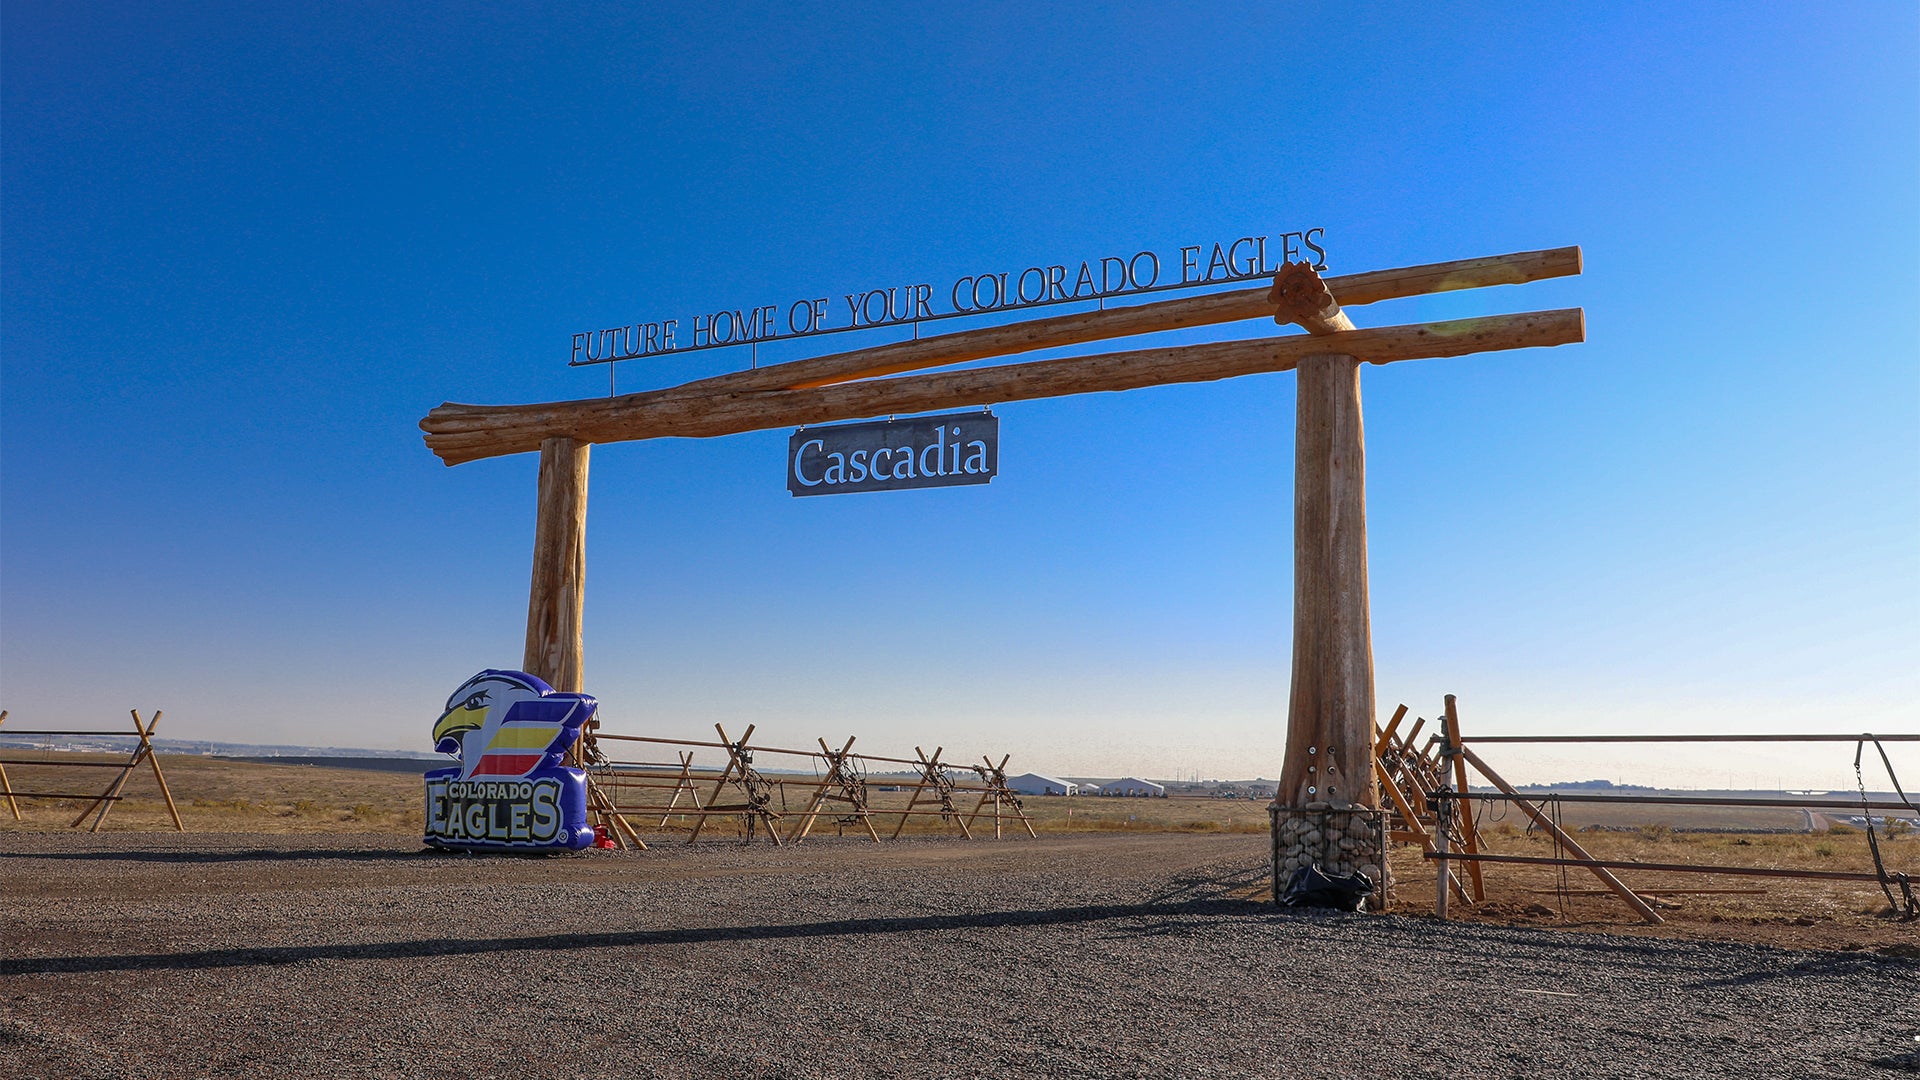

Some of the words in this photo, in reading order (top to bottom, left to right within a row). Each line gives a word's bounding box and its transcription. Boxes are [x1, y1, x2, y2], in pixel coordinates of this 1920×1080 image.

[570, 320, 678, 364] FUTURE
[693, 305, 777, 347] HOME
[788, 298, 828, 334] OF
[845, 283, 933, 327] YOUR
[951, 251, 1159, 313] COLORADO
[1180, 228, 1327, 284] EAGLES
[794, 425, 990, 486] Cascadia
[428, 783, 558, 839] EAGLES
[450, 781, 532, 799] COLORADO
